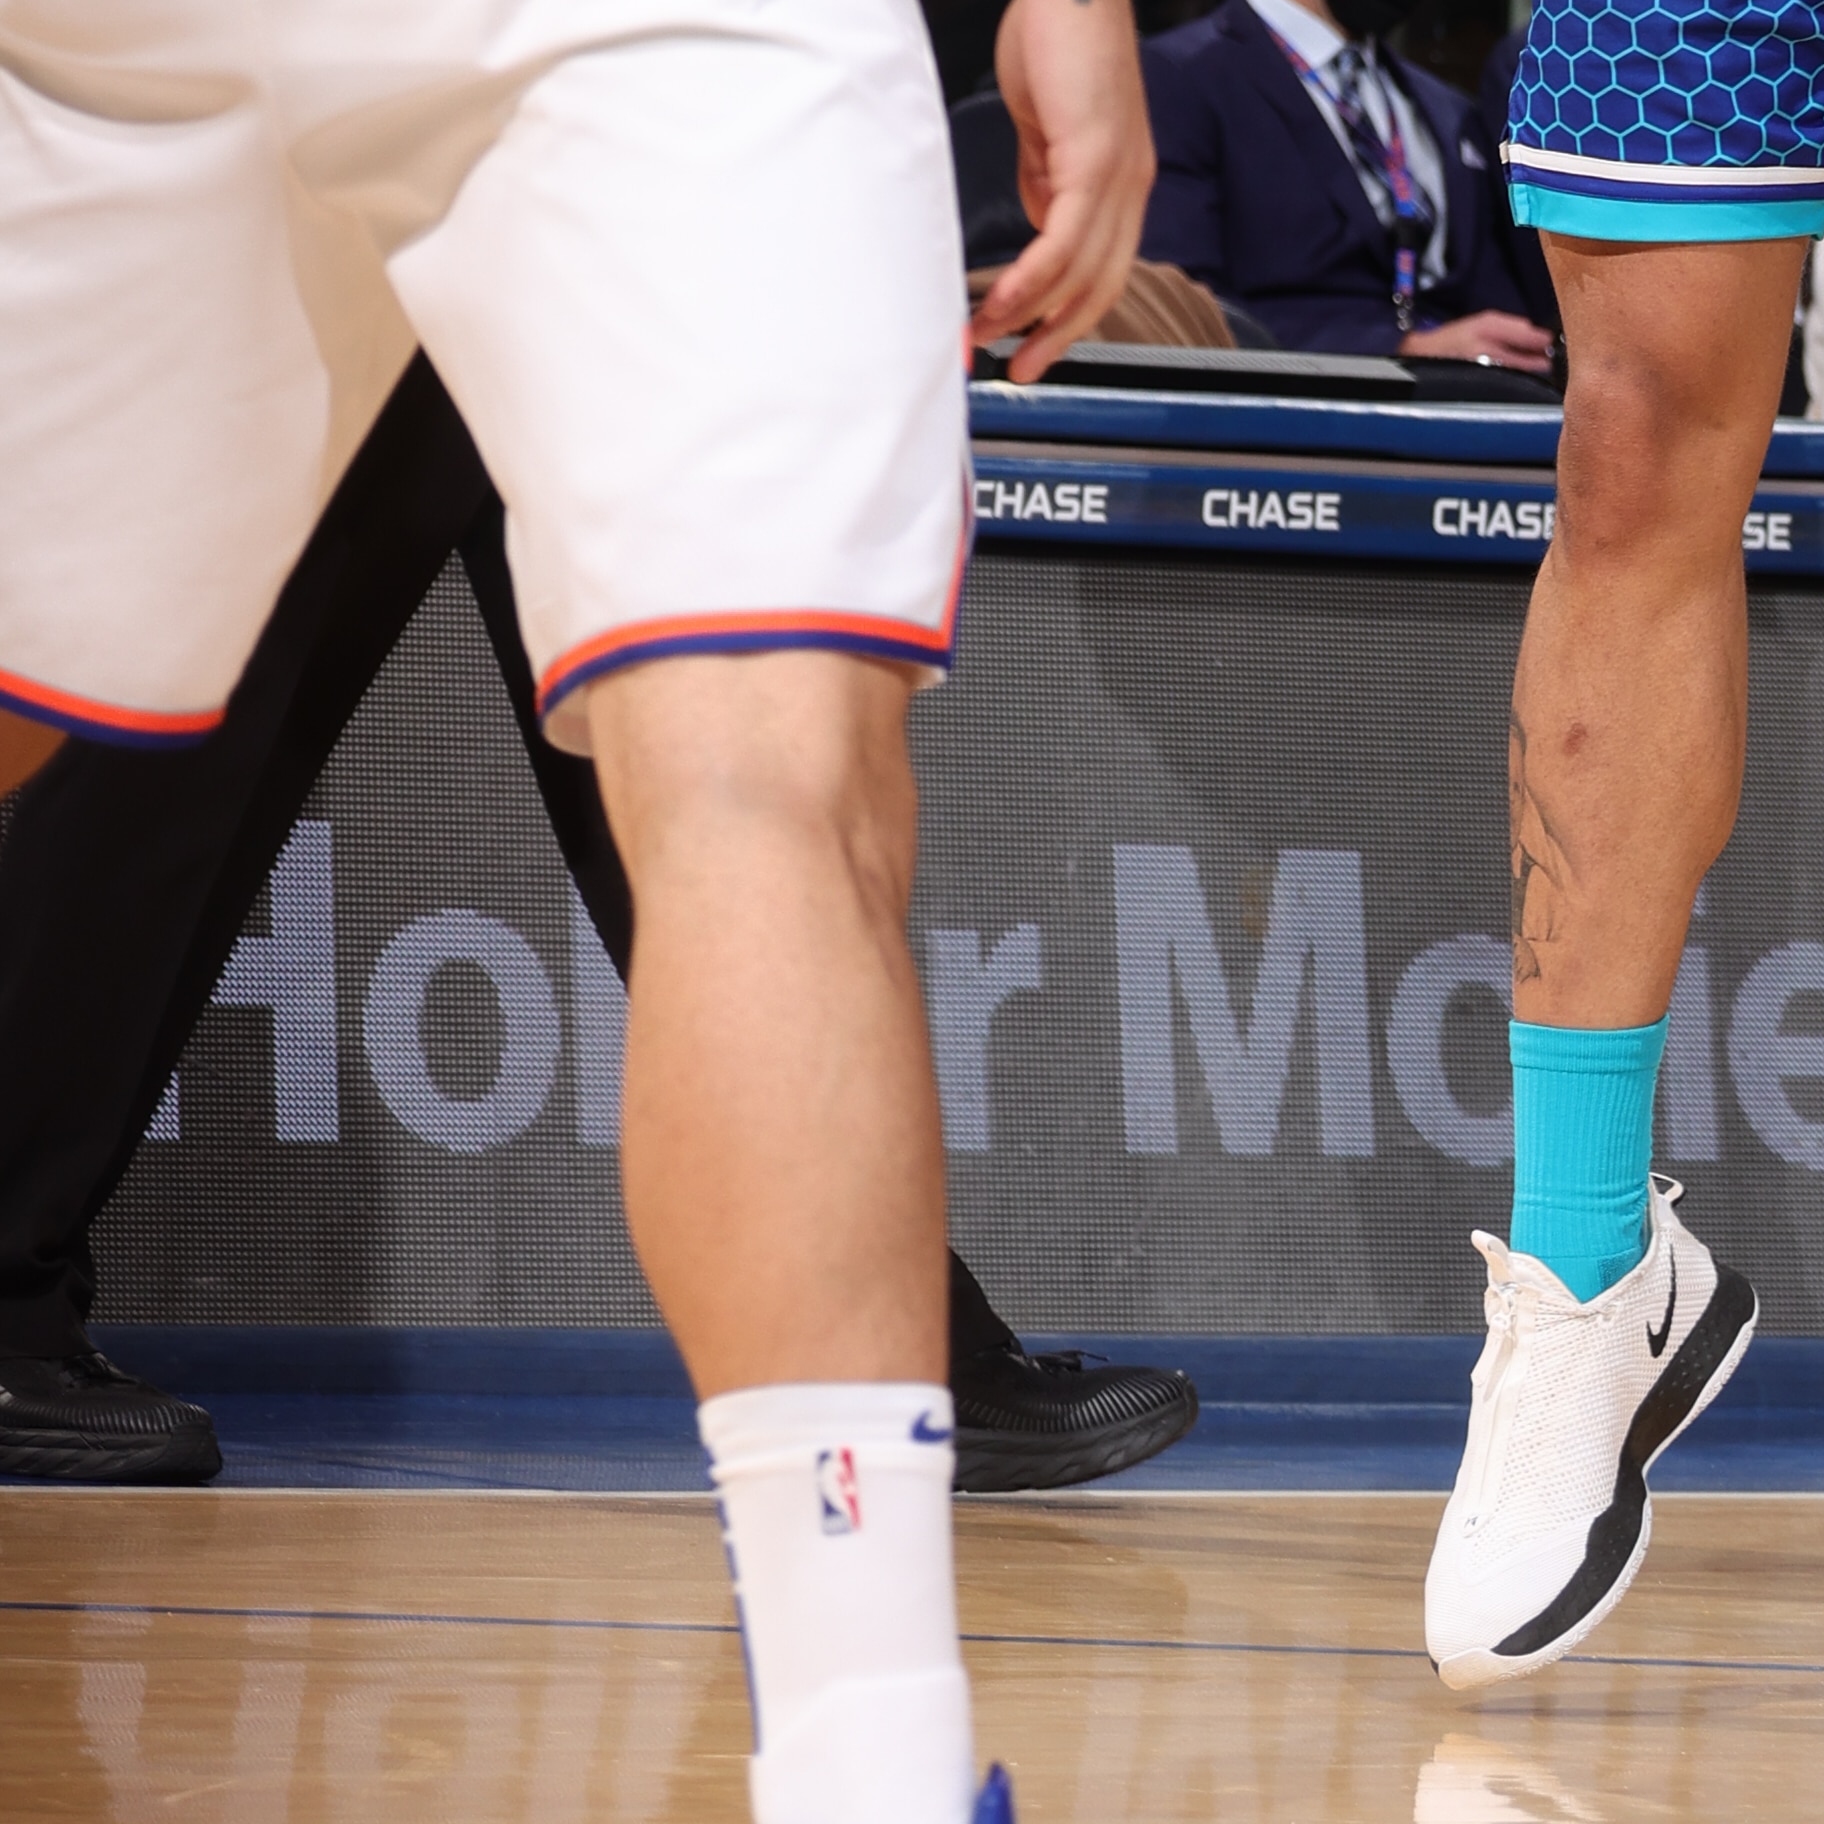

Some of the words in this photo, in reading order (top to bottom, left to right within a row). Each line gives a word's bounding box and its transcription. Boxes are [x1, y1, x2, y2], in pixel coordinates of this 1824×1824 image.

[974, 479, 1110, 524] CHASE
[1201, 488, 1343, 532] CHASE
[143, 818, 1042, 1153] Holr
